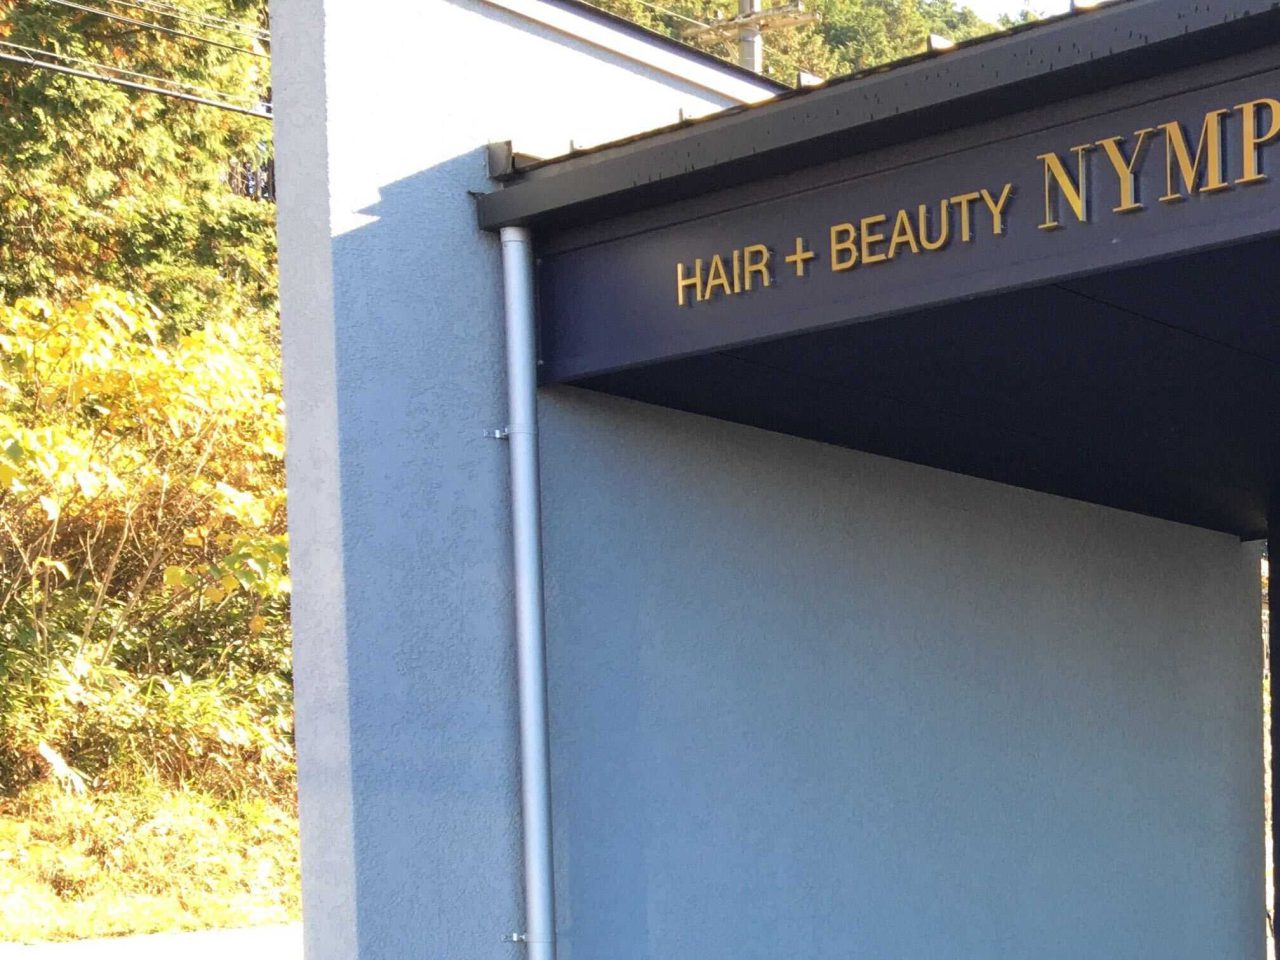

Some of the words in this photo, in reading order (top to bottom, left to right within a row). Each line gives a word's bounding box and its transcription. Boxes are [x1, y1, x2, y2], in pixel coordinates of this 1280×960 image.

[676, 244, 772, 307] HAIR
[784, 237, 815, 277] +
[829, 182, 1014, 273] BEAUTY
